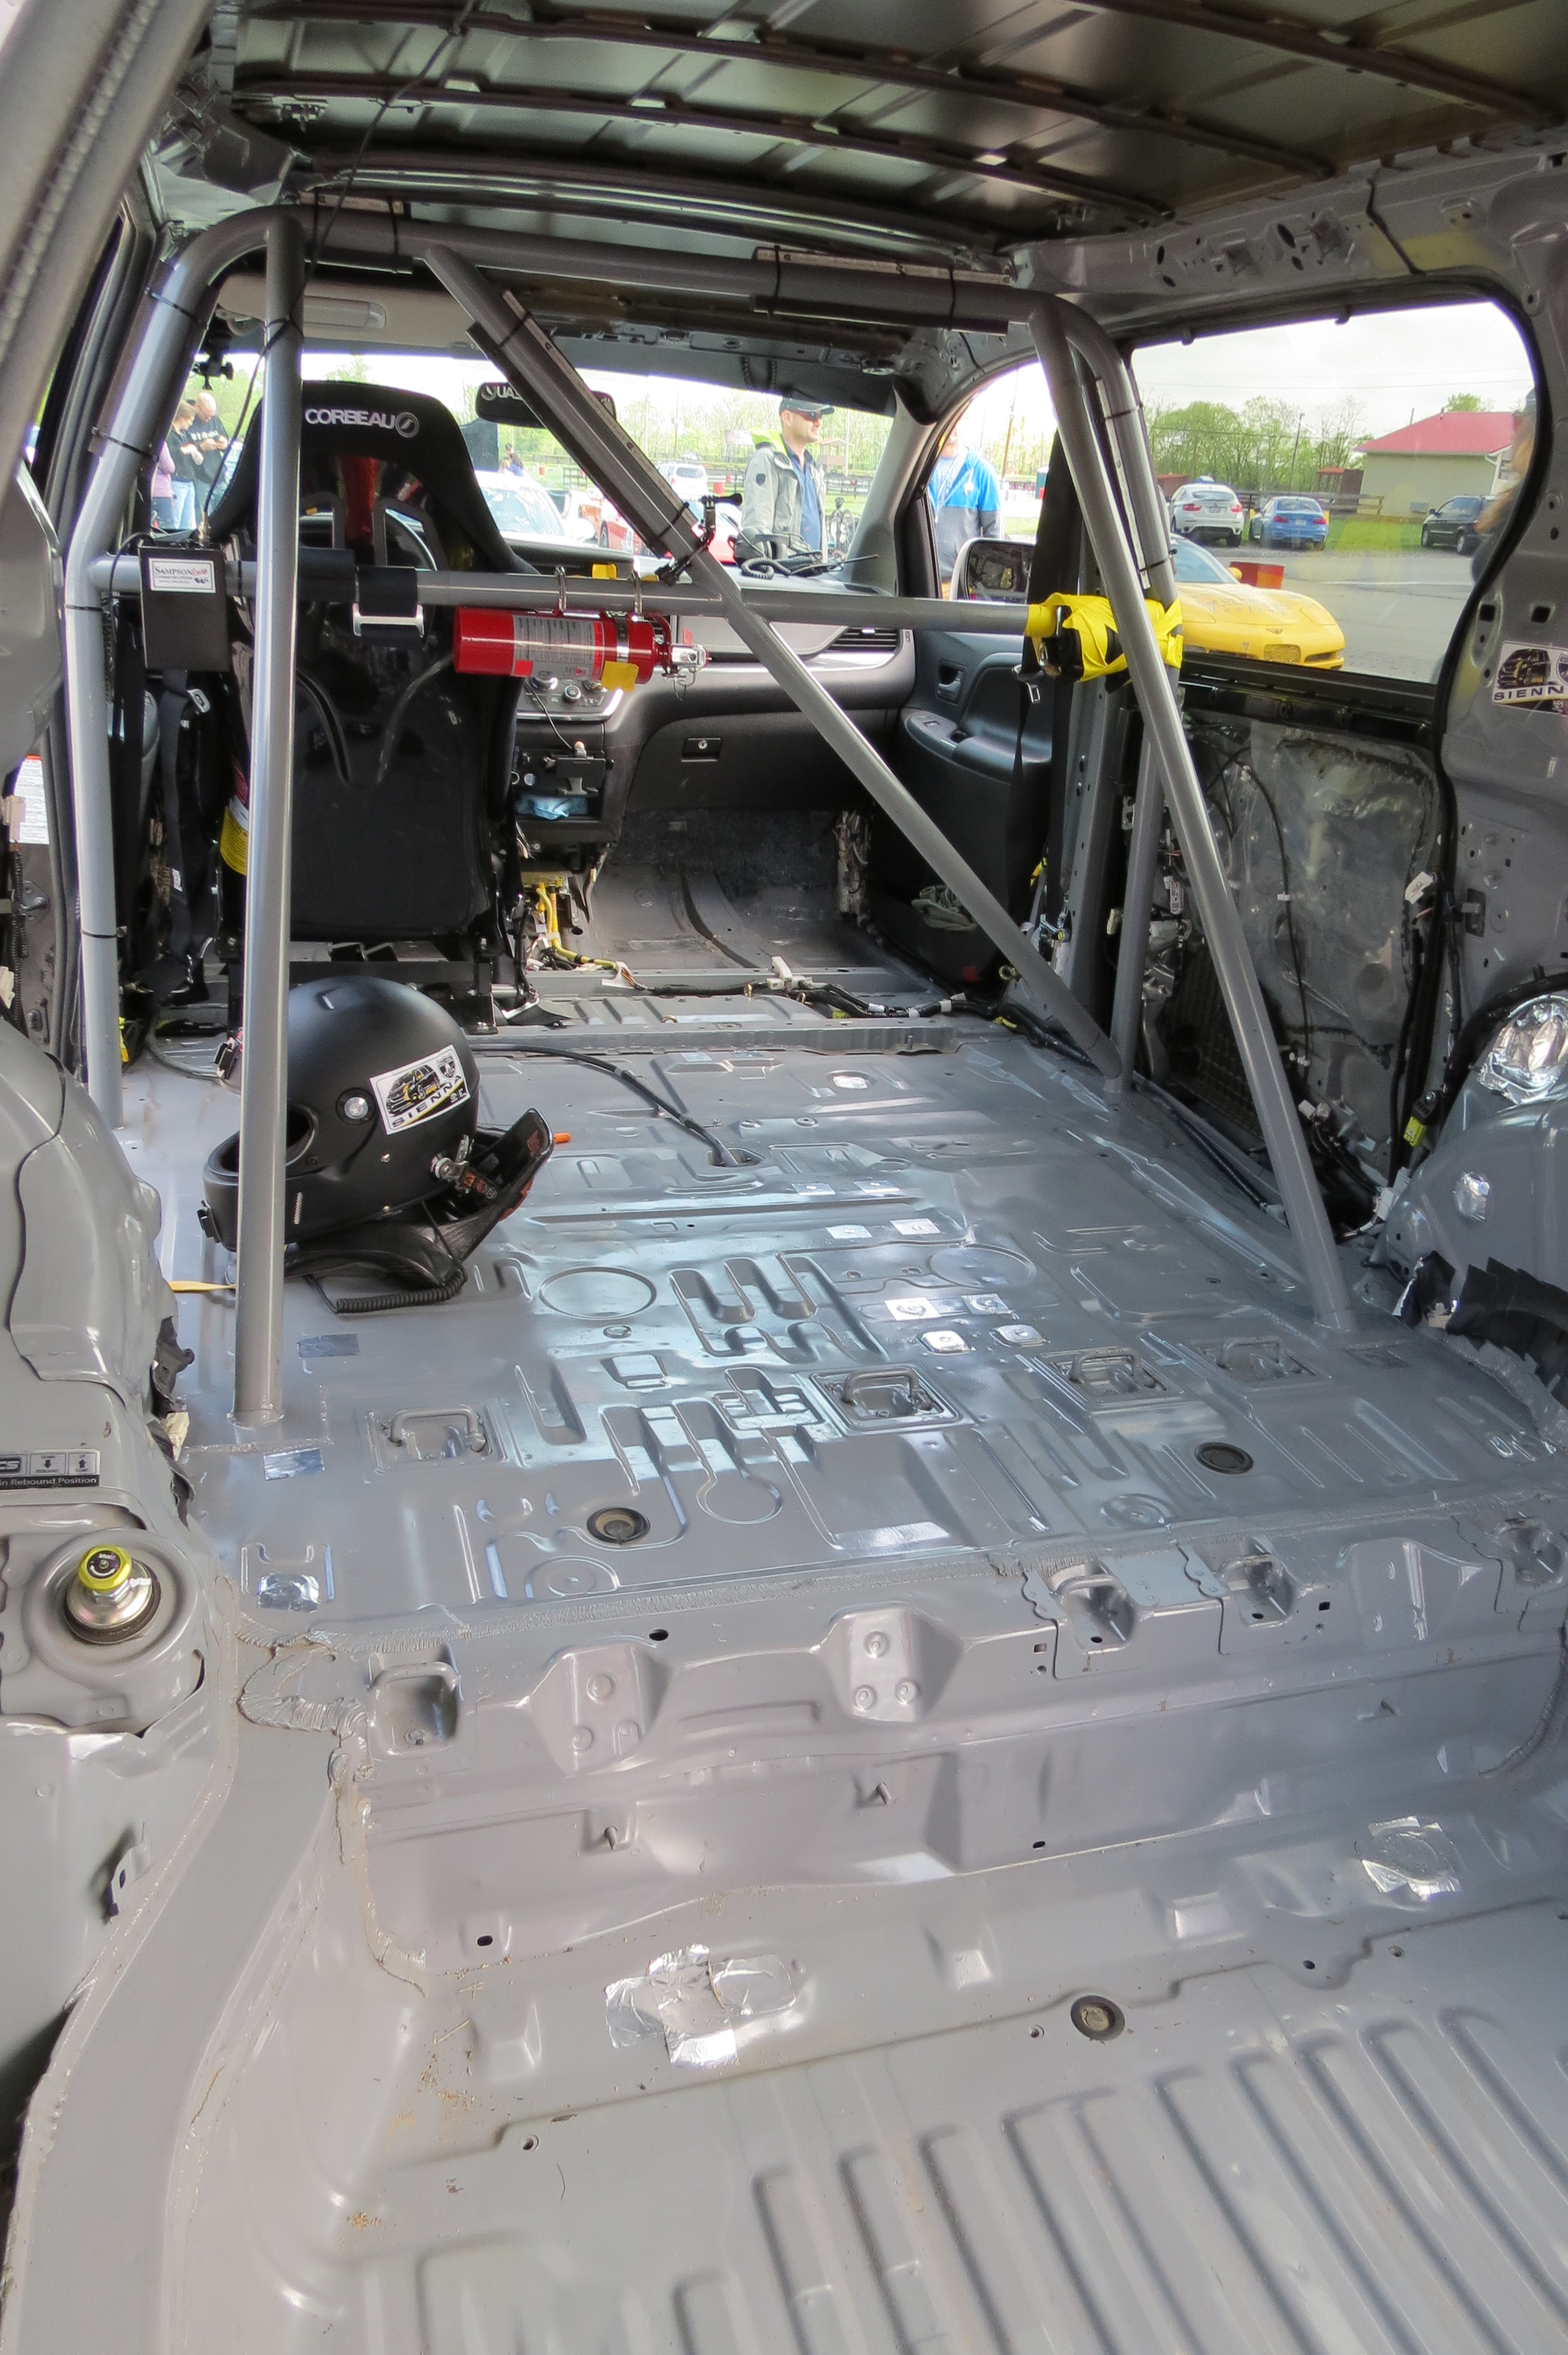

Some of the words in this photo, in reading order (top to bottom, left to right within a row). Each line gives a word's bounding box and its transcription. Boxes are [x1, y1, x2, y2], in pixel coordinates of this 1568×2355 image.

[305, 409, 396, 429] CORBEAU
[391, 1075, 462, 1128] SIENNA
[11, 1477, 55, 1485] Rebound
